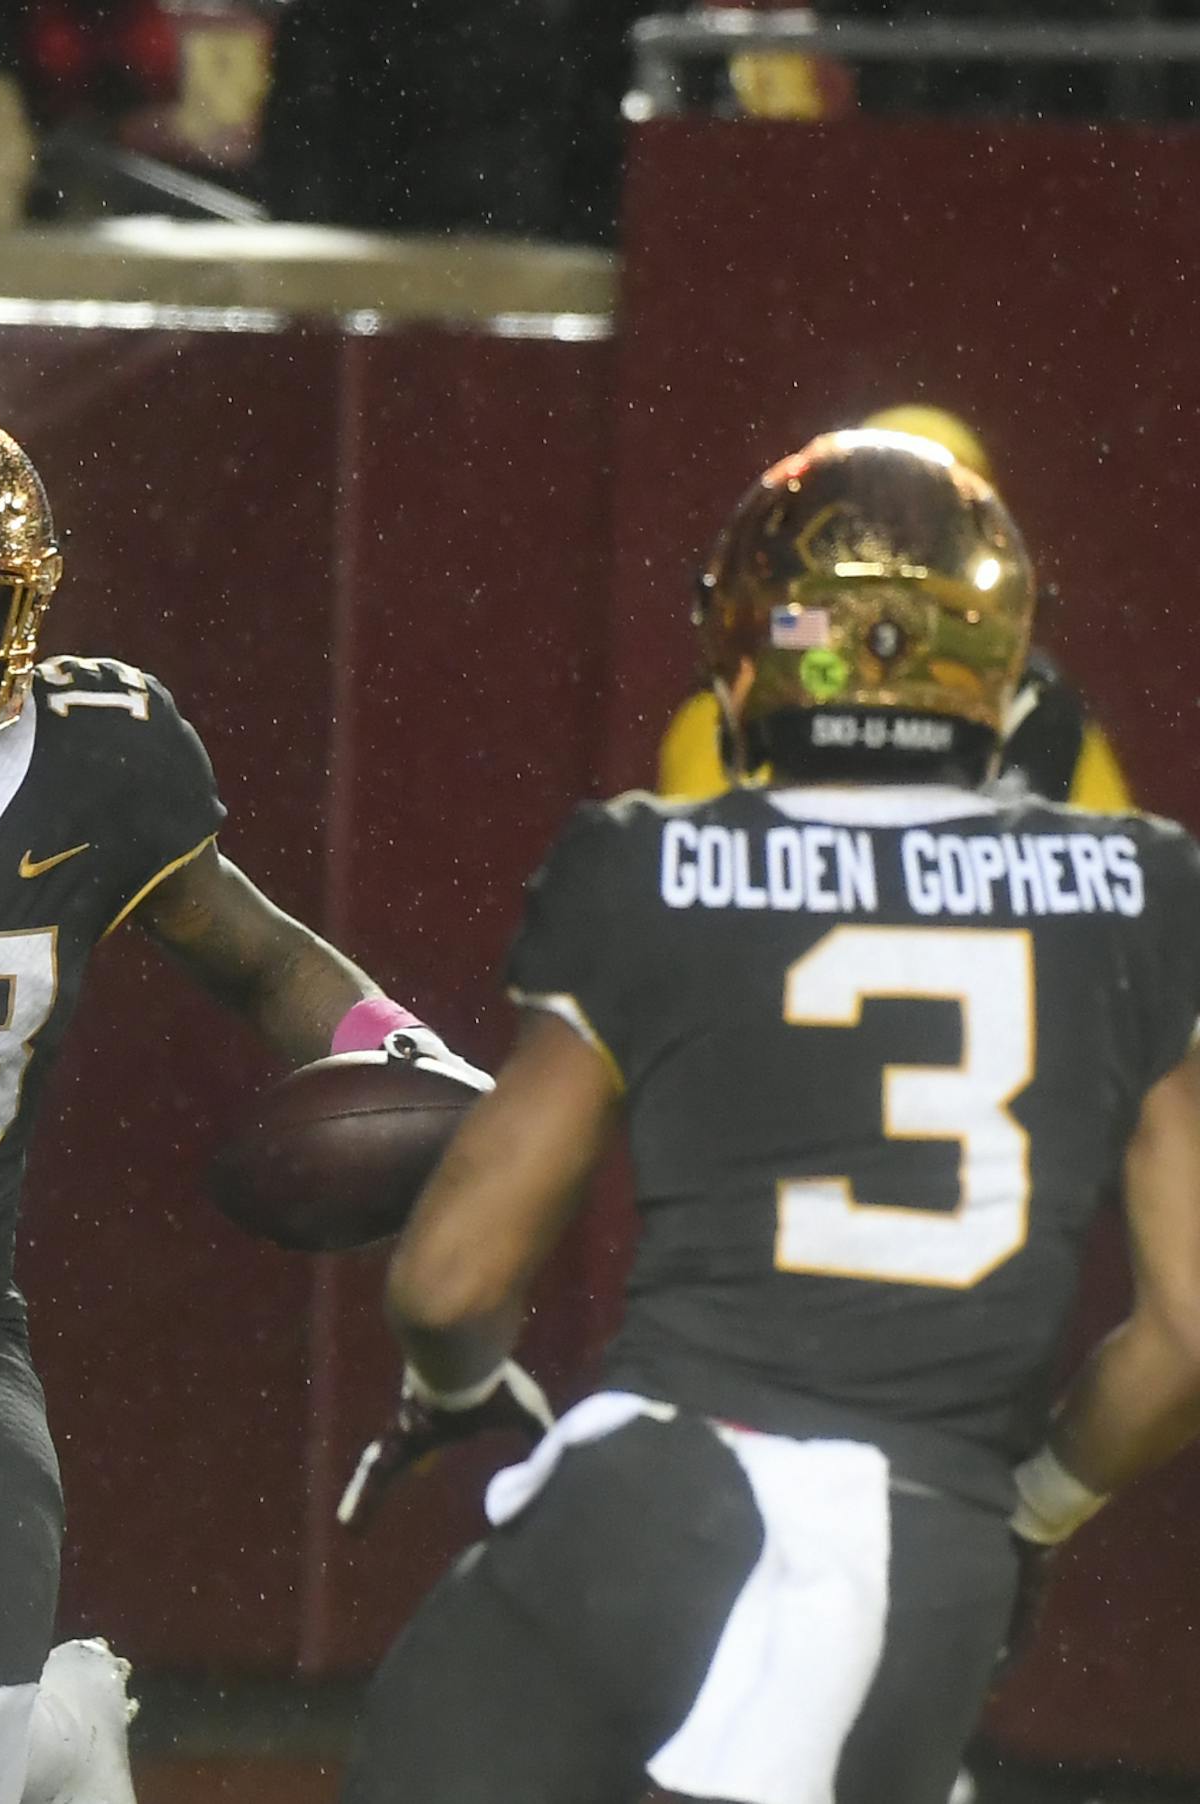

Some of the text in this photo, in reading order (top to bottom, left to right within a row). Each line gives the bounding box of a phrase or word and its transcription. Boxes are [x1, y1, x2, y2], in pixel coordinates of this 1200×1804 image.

[661, 820, 1146, 918] GOLDEN GOPHERS
[773, 922, 1039, 1291] 3
